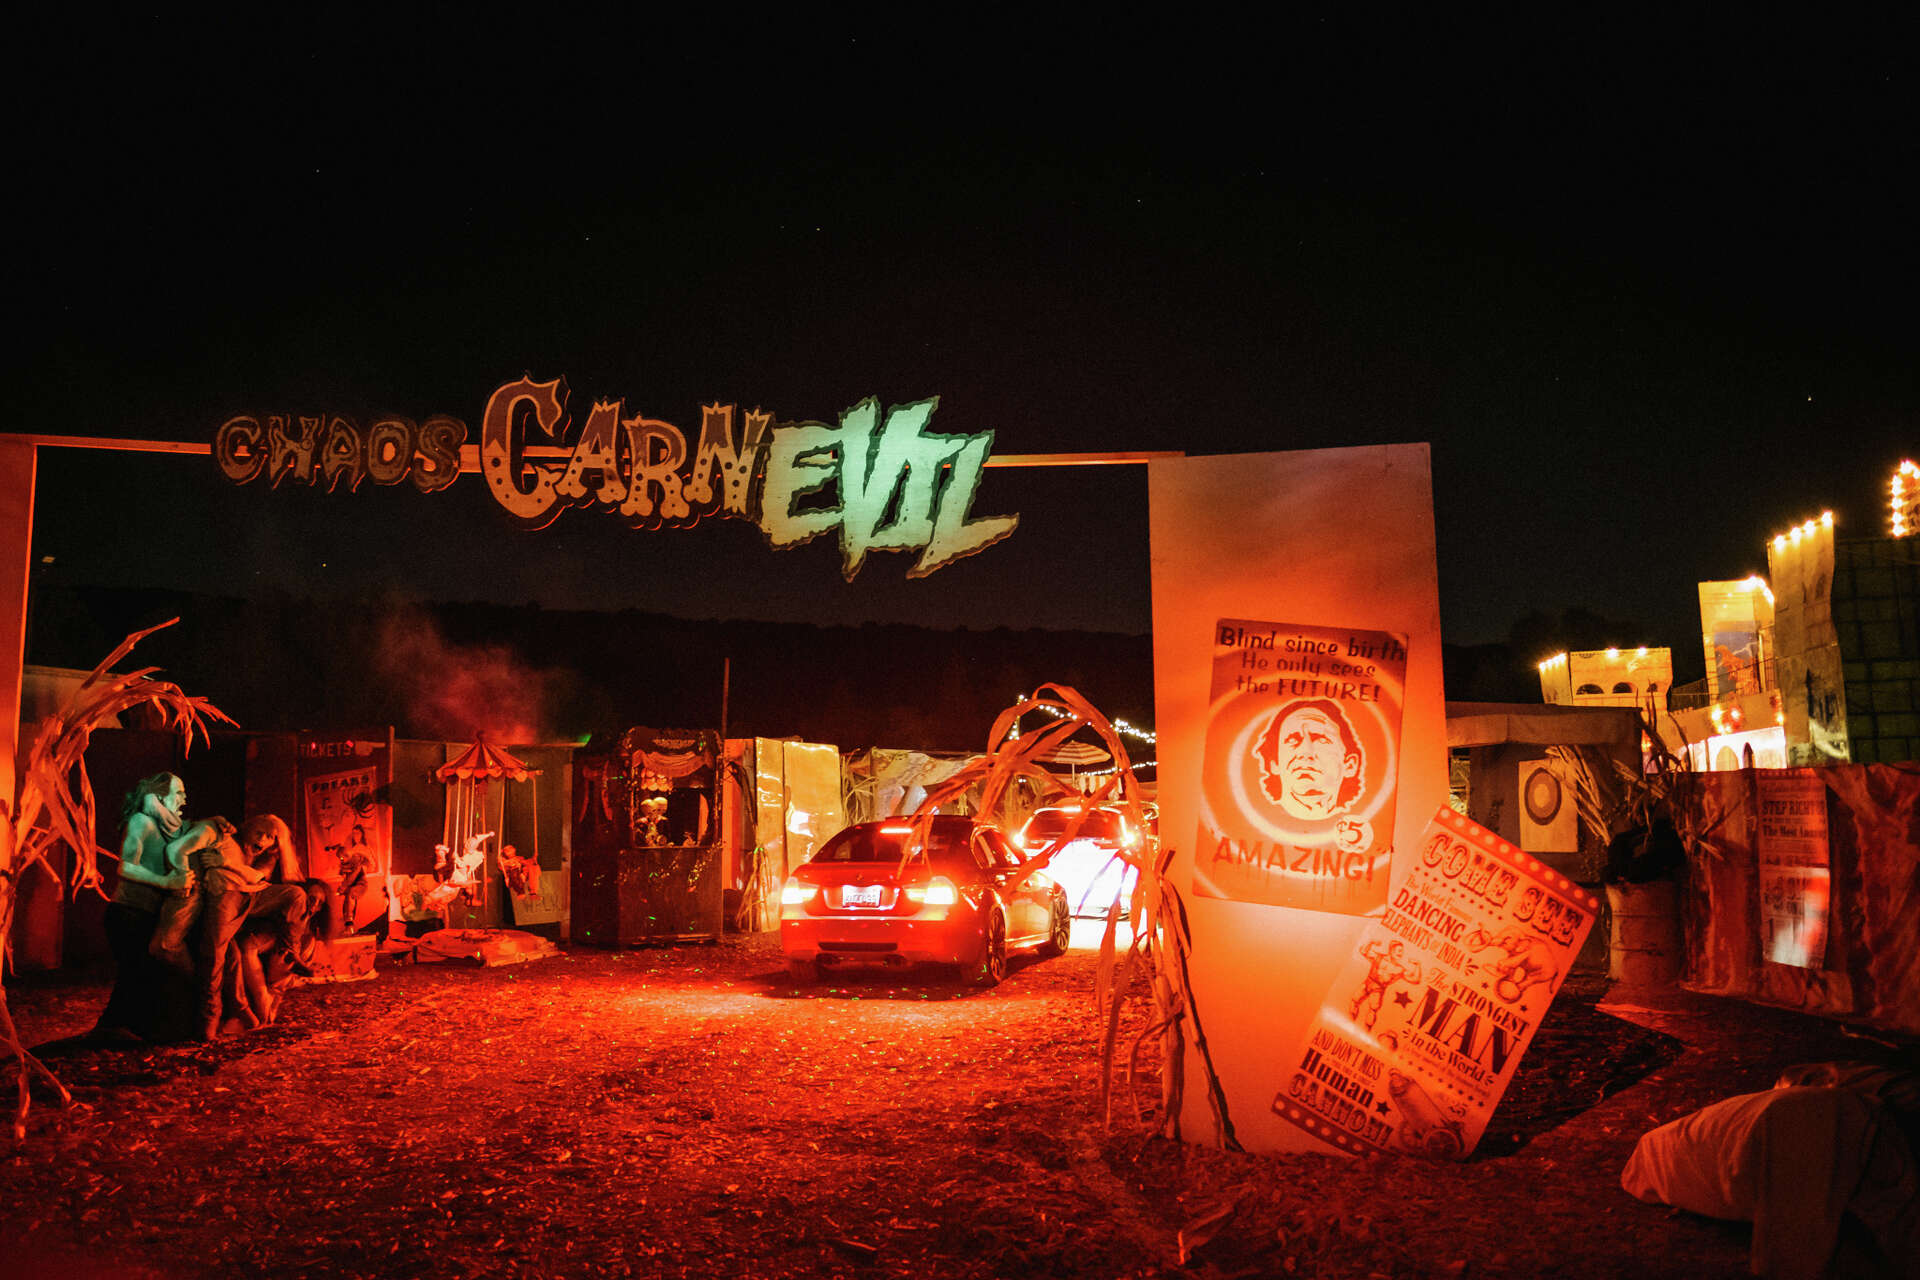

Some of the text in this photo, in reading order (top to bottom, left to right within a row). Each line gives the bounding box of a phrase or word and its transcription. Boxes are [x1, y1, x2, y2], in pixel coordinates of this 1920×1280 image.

[216, 413, 468, 493] CHAOS
[1220, 626, 1406, 662] Blind since birth
[1242, 652, 1376, 678] He only sees
[1236, 675, 1380, 702] the FUTURE!
[1213, 837, 1375, 882] AMAZING!
[1393, 888, 1466, 943] DANCING
[1423, 834, 1519, 907] COME
[1513, 887, 1584, 947] SEE
[1381, 908, 1435, 950] ELEPHANTS
[1437, 943, 1466, 970] INDIA
[1407, 985, 1521, 1075] MAN
[1427, 967, 1530, 1037] The STRONGEST
[1300, 1048, 1374, 1107] Human
[1312, 1028, 1335, 1050] AND
[1331, 1039, 1362, 1066] DON'T
[1359, 1055, 1385, 1080] MISS
[1425, 1041, 1447, 1060] the
[1447, 1054, 1486, 1081] World
[1288, 1073, 1394, 1146] CANNON!
